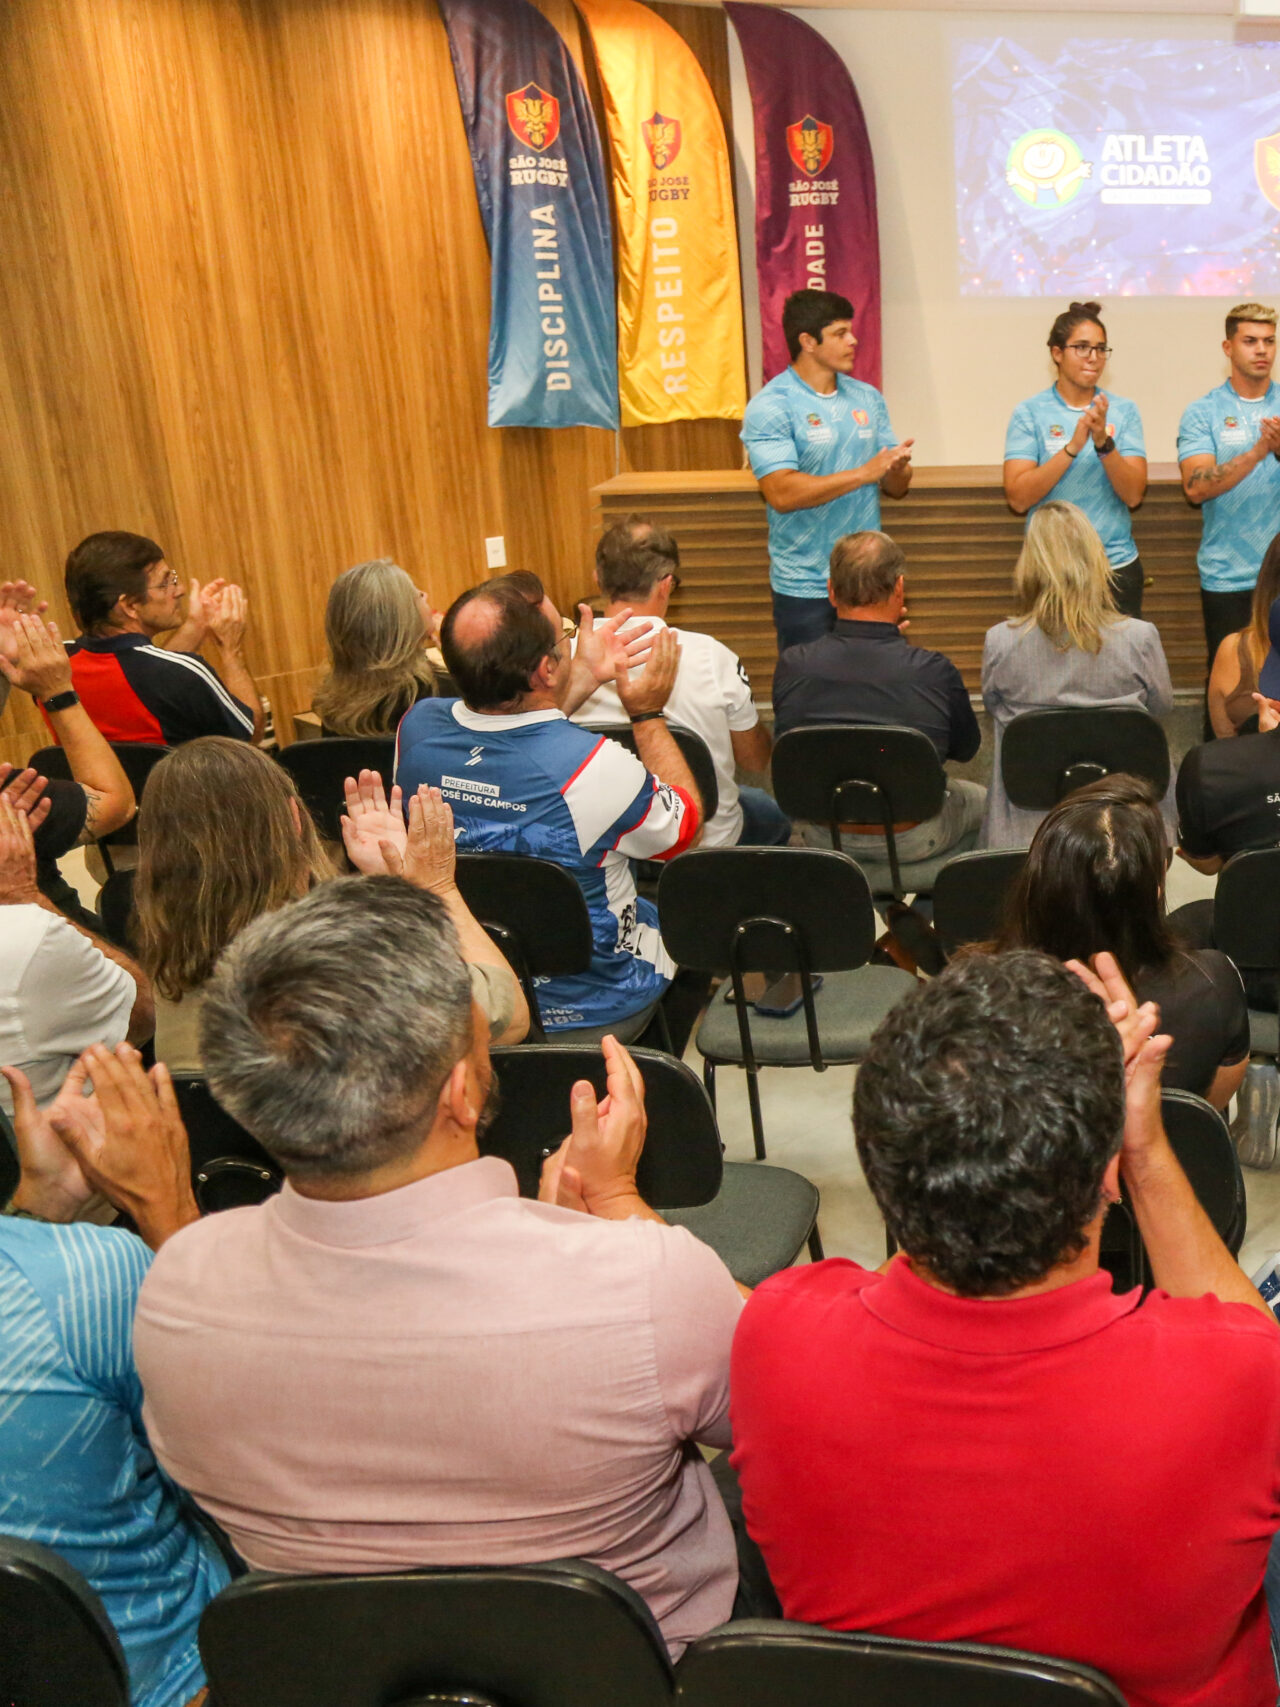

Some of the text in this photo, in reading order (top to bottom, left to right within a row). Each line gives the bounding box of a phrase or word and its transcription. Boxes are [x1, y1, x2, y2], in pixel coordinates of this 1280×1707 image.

[1101, 134, 1209, 162] ATLETA
[509, 154, 568, 171] SÃO JOSÉ
[510, 169, 568, 187] RUGBY
[1101, 162, 1212, 186] CIDADÃO
[788, 178, 839, 192] SÃO JOSÉ
[648, 188, 690, 202] UGBY
[789, 192, 839, 207] RUGBY
[529, 204, 572, 391] DISCIPLINA
[650, 216, 689, 395] RESPEITO
[444, 777, 497, 796] PREFEITURA
[440, 789, 527, 812] OSÉ DOS CAMPOS
